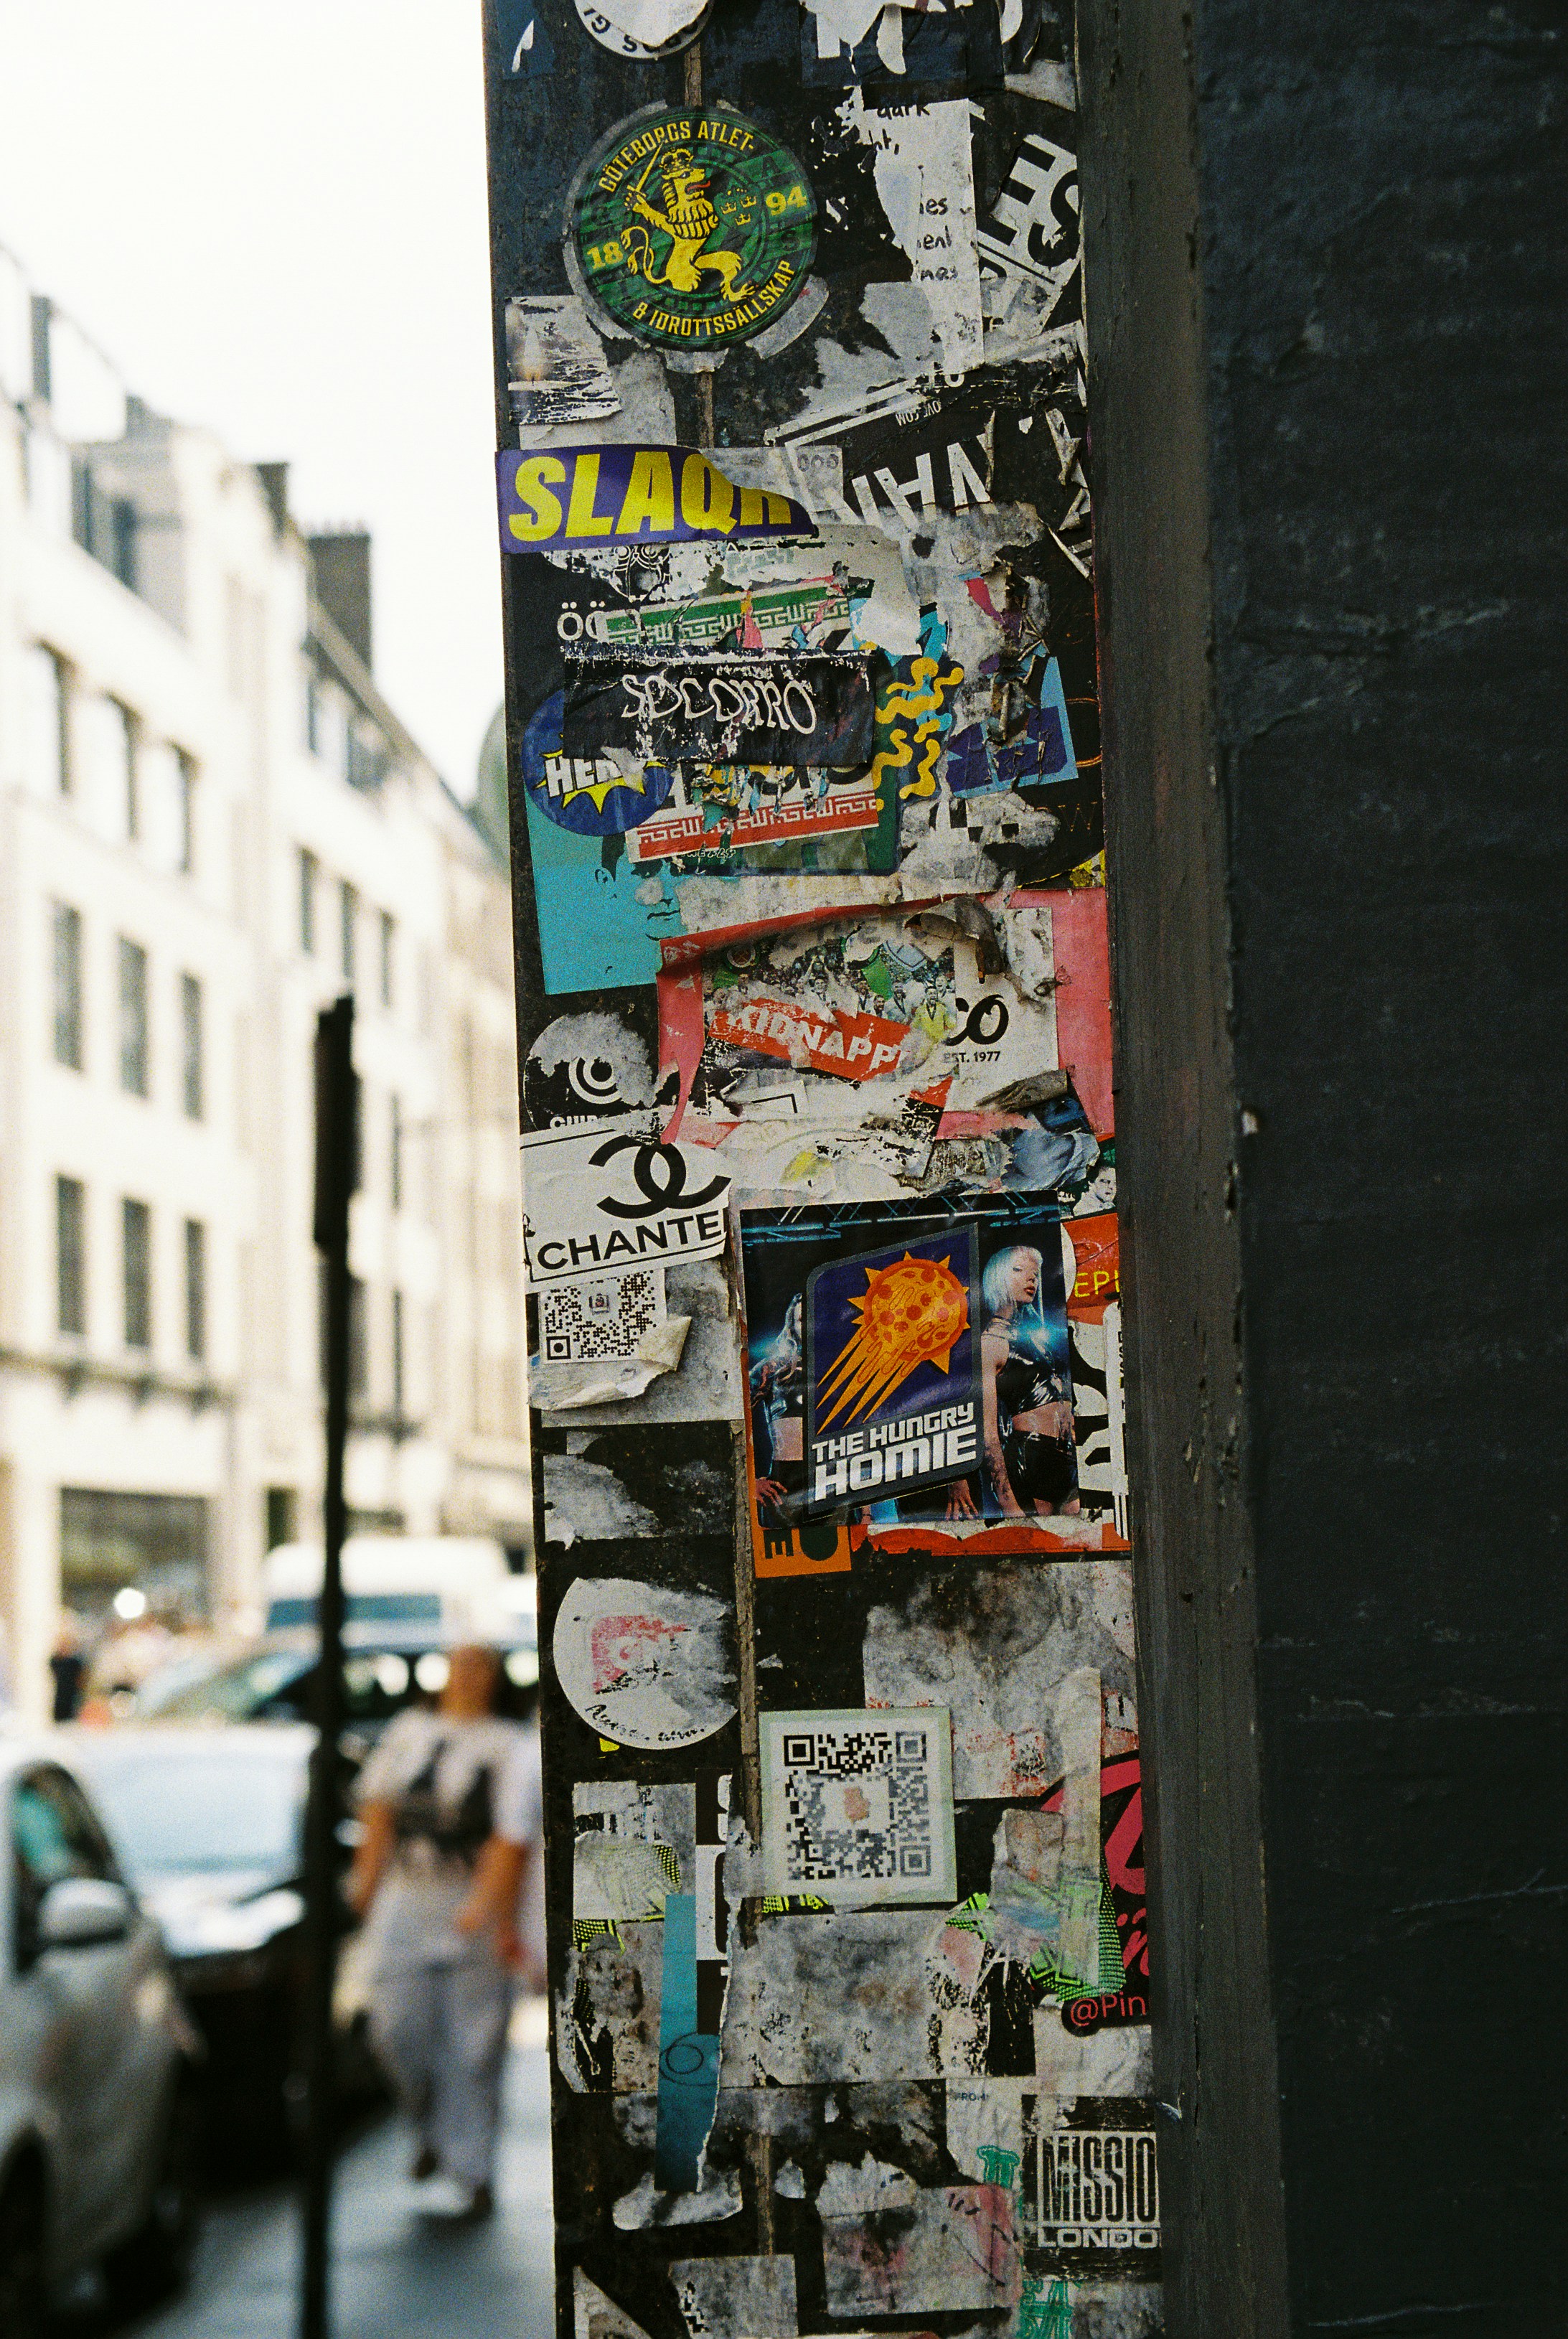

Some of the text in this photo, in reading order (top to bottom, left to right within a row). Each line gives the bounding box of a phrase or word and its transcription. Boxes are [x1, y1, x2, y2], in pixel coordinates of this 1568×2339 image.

[598, 121, 691, 192] GÖTEBORGS
[587, 185, 807, 269] 18 94
[648, 260, 795, 337] IDROTTSSÄLLSKAP
[973, 1051, 1001, 1062] 1977
[811, 1402, 975, 1463] THE HUNGRY
[814, 1424, 977, 1501] HOMIE
